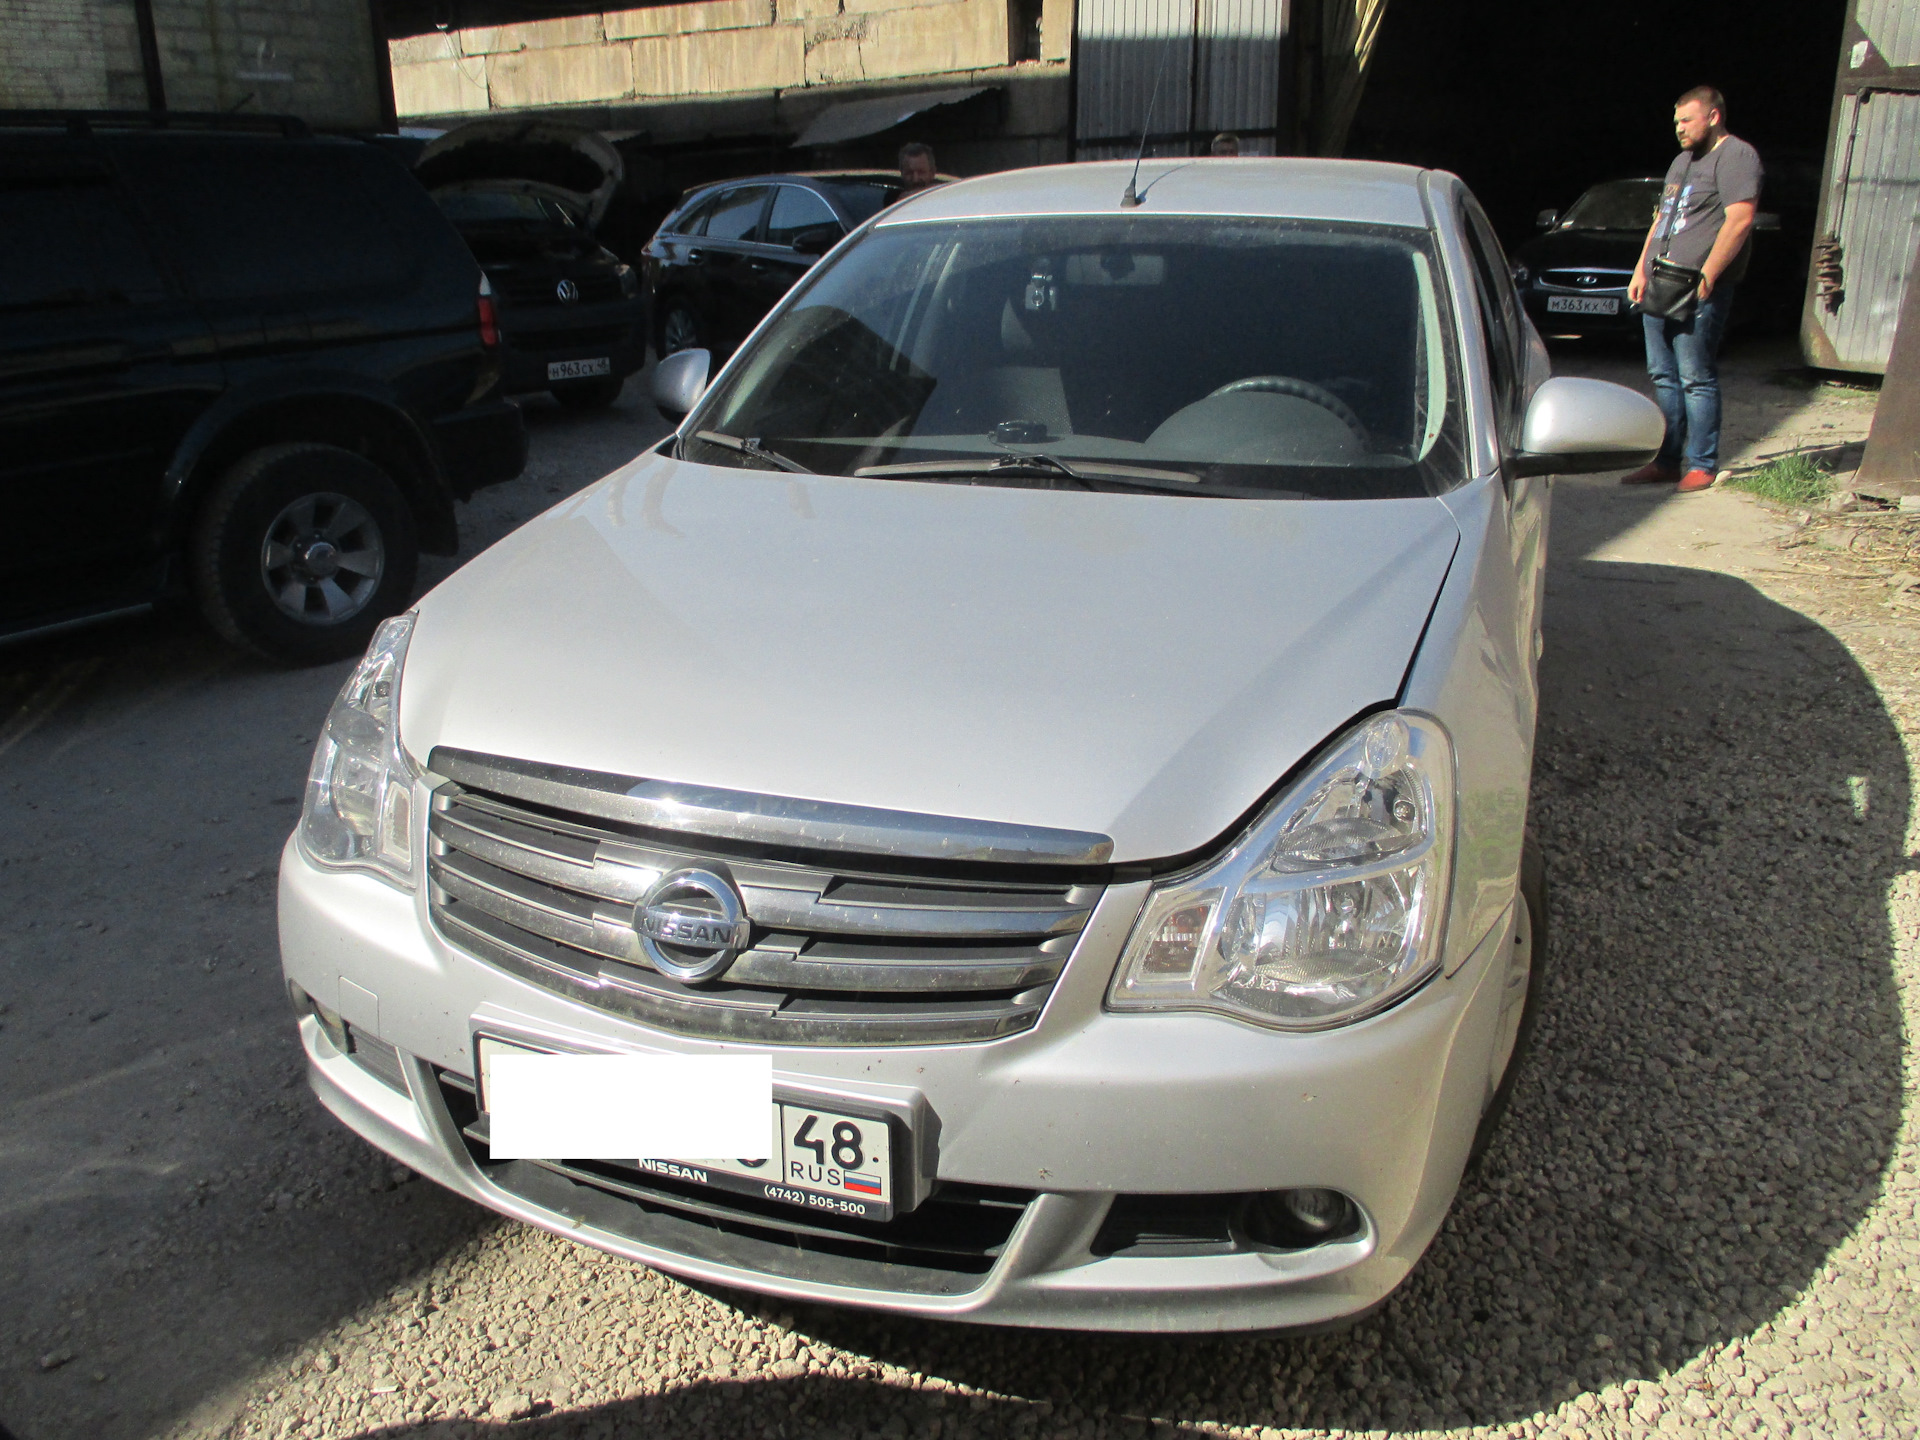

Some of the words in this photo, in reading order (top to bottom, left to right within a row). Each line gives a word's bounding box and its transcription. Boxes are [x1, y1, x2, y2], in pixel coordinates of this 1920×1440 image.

[641, 917, 732, 944] NISSAN
[794, 1114, 864, 1170] 48
[639, 1158, 708, 1183] NISSAN
[790, 1161, 841, 1187] RUS
[764, 1184, 805, 1204] (4742)
[809, 1195, 866, 1215] 505-500
